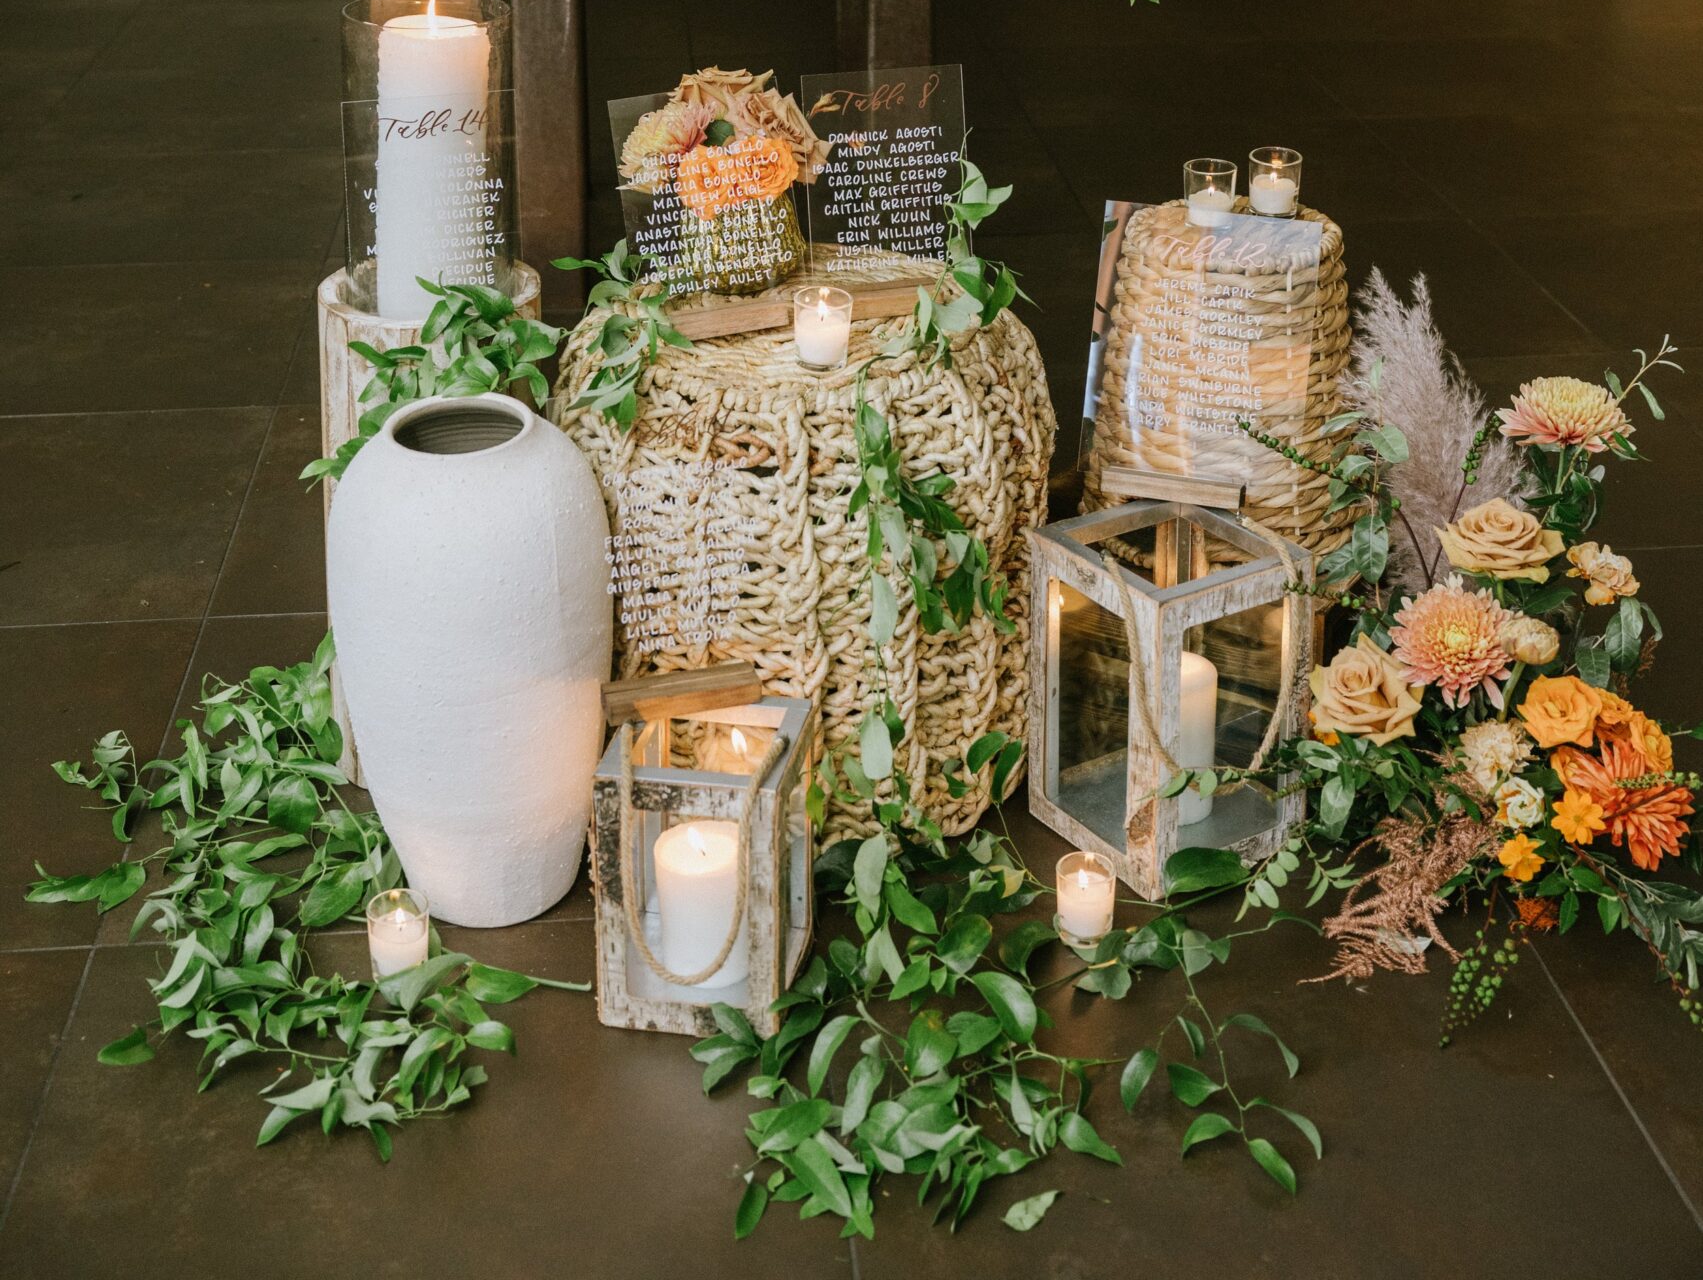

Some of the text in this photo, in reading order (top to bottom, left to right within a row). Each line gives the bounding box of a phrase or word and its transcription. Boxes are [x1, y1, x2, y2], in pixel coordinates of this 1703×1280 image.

[832, 73, 939, 116] Table 8
[369, 109, 489, 142] Table 14
[828, 126, 942, 144] DOMINICK AGOSTI
[706, 140, 764, 158] BONELLO
[838, 141, 935, 158] MINDY AGOSTI
[718, 152, 779, 170] BONELLO
[813, 151, 960, 175] ISAAC DUNKELBERGER
[652, 169, 760, 196] MARIA BONELLO
[828, 168, 947, 186] CAROLINE CREWS
[653, 183, 765, 211] MATTHEW HEIGL
[834, 182, 942, 201] MAX GRIFFITHS
[647, 197, 774, 225] VINCENT BONELLO
[824, 194, 952, 215] CAITLIN GRIFFITHS
[445, 220, 494, 234] DICKER
[848, 210, 930, 228] NICK KUHN
[639, 223, 784, 256] SAMANTHA BONELLO
[837, 223, 945, 243] ERIN WILLIAMS
[836, 237, 944, 257] JUSTIN MILLER
[1155, 235, 1266, 268] Table 12
[641, 268, 694, 285] JOSEPH
[669, 269, 772, 295] ASHLEY AULET
[1160, 294, 1244, 309] JILL CAPIK
[1150, 348, 1180, 358] LORI
[1178, 378, 1262, 396] SWINBURNE
[638, 635, 676, 652] NINA
